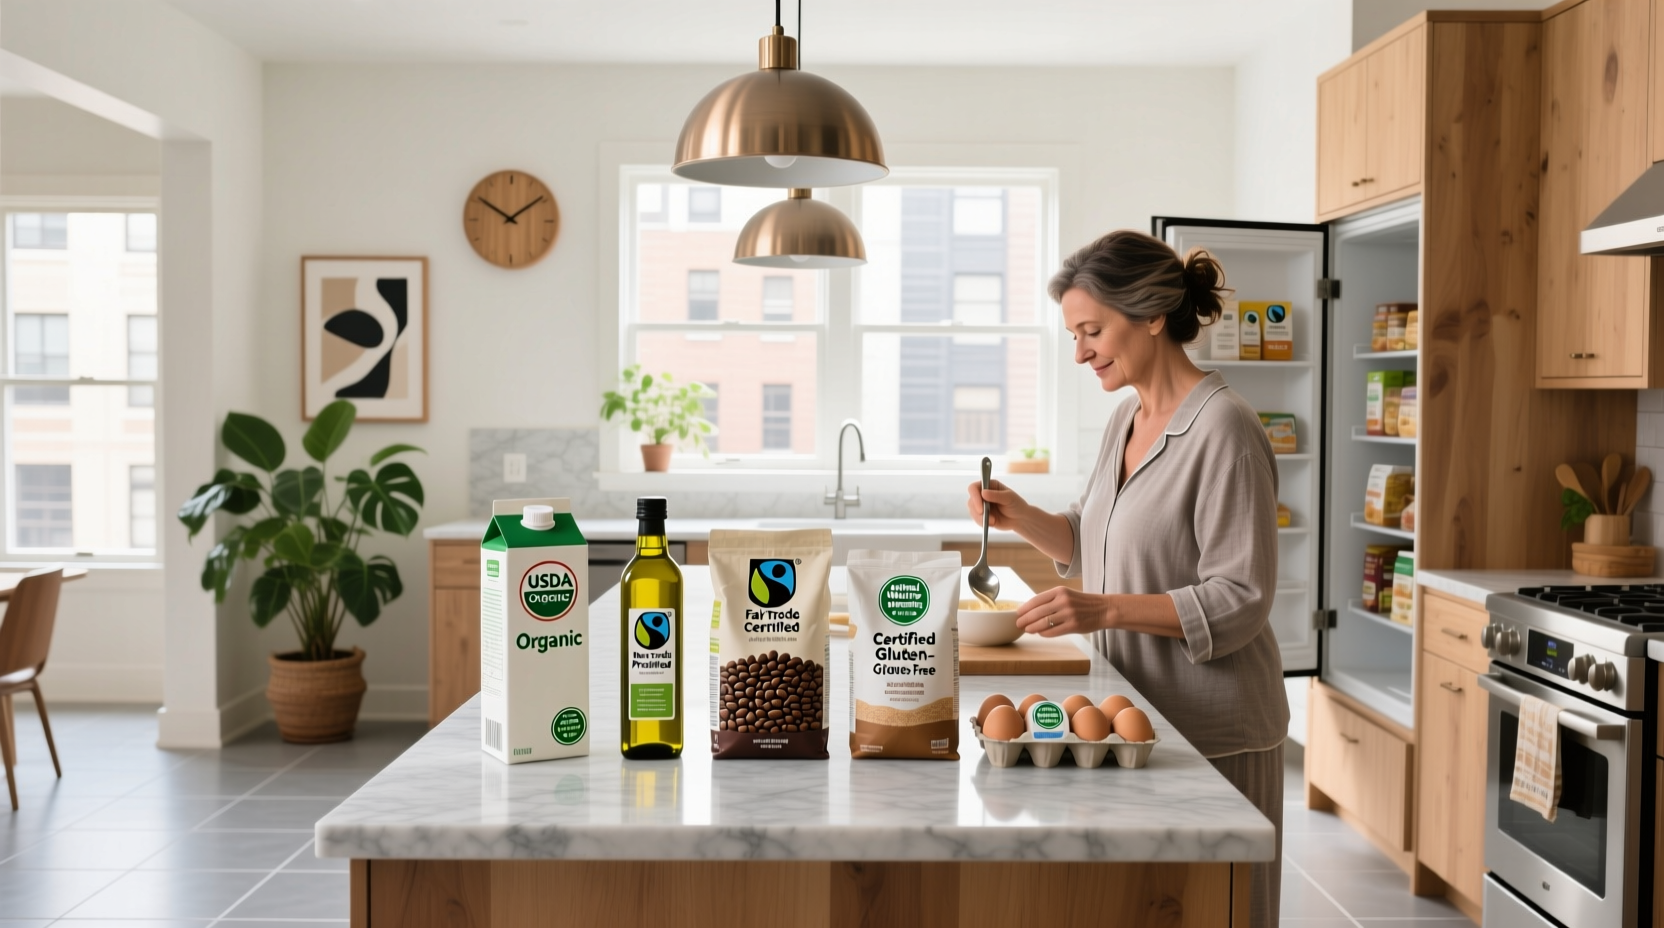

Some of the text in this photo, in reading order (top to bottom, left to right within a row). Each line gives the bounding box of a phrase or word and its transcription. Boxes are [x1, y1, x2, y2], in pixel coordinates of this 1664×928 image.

[528, 572, 574, 589] USDA
[516, 629, 583, 653] Organic
[873, 631, 936, 645] Certified
